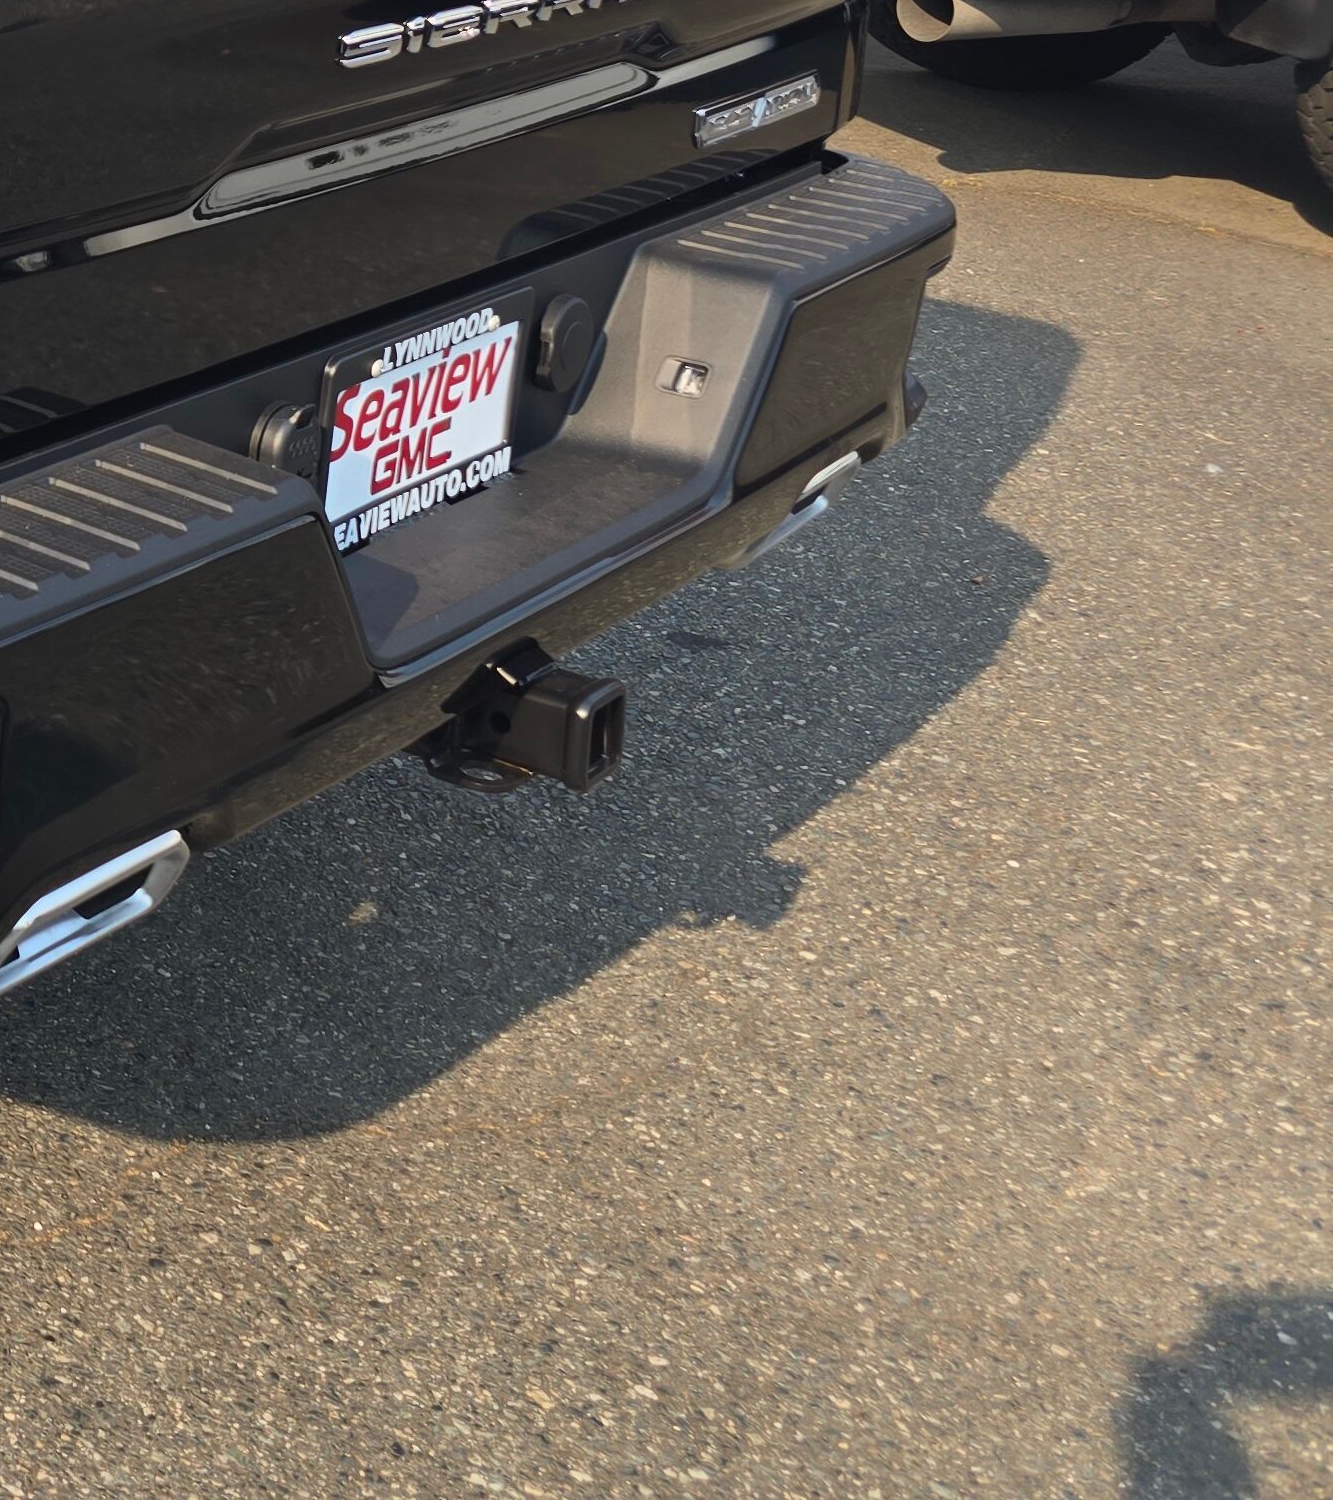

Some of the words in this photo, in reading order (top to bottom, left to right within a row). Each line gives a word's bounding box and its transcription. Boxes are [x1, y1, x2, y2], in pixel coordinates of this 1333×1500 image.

[381, 307, 494, 372] LYNNWOOD
[330, 336, 513, 462] Seaview
[333, 446, 511, 551] EAVIEWAUTO.COM
[370, 417, 452, 495] GMC
